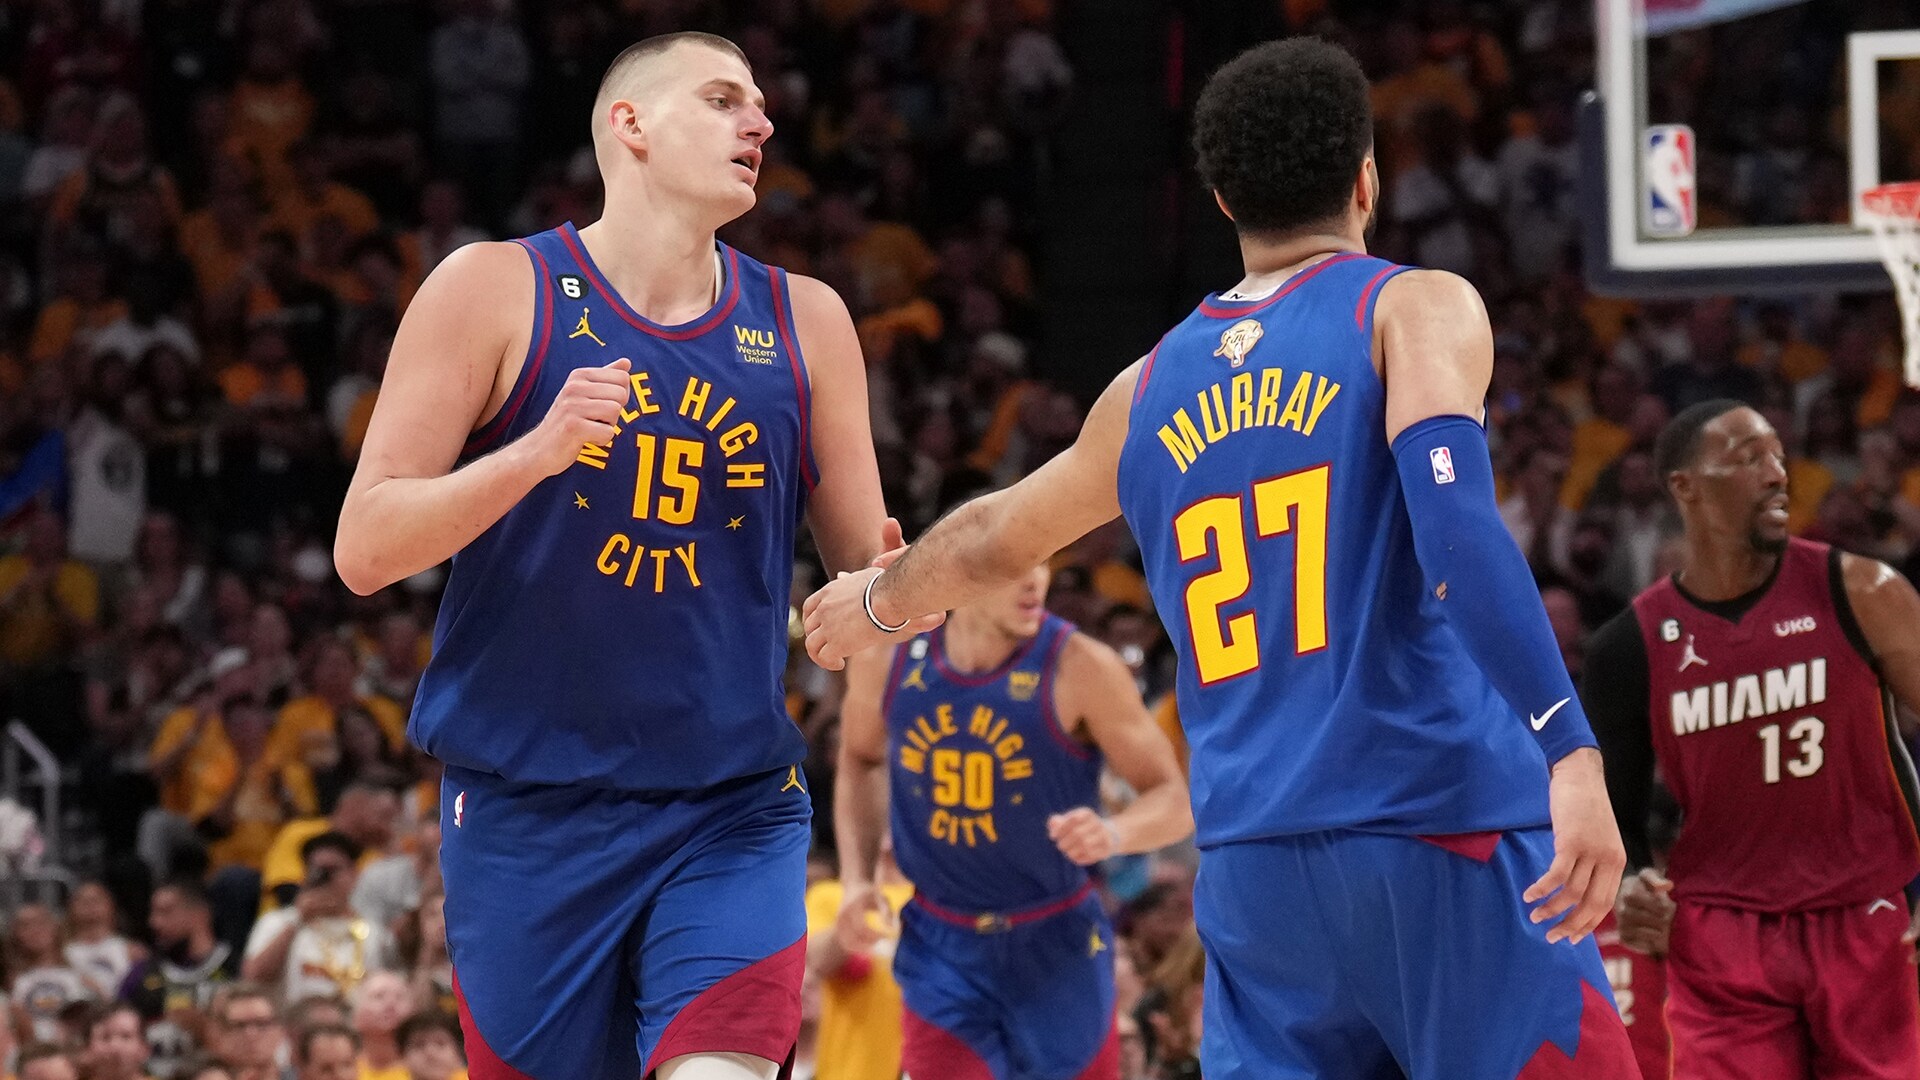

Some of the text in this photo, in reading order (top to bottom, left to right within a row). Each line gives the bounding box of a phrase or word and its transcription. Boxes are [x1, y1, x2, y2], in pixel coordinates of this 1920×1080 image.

[563, 276, 581, 298] 6
[734, 324, 775, 348] WU
[736, 345, 777, 358] Western
[744, 354, 772, 365] Union
[576, 372, 765, 489] MLE HIGH
[1157, 367, 1340, 474] MURRAY
[632, 433, 704, 525] 15
[596, 533, 702, 593] CITY
[1174, 461, 1331, 687] 27
[1662, 619, 1680, 642] 6
[1671, 657, 1827, 737] MIAMI
[901, 704, 1034, 781] MILE HIGH
[1758, 716, 1825, 783] 13
[932, 748, 994, 811] 50
[929, 808, 998, 848] CITY
